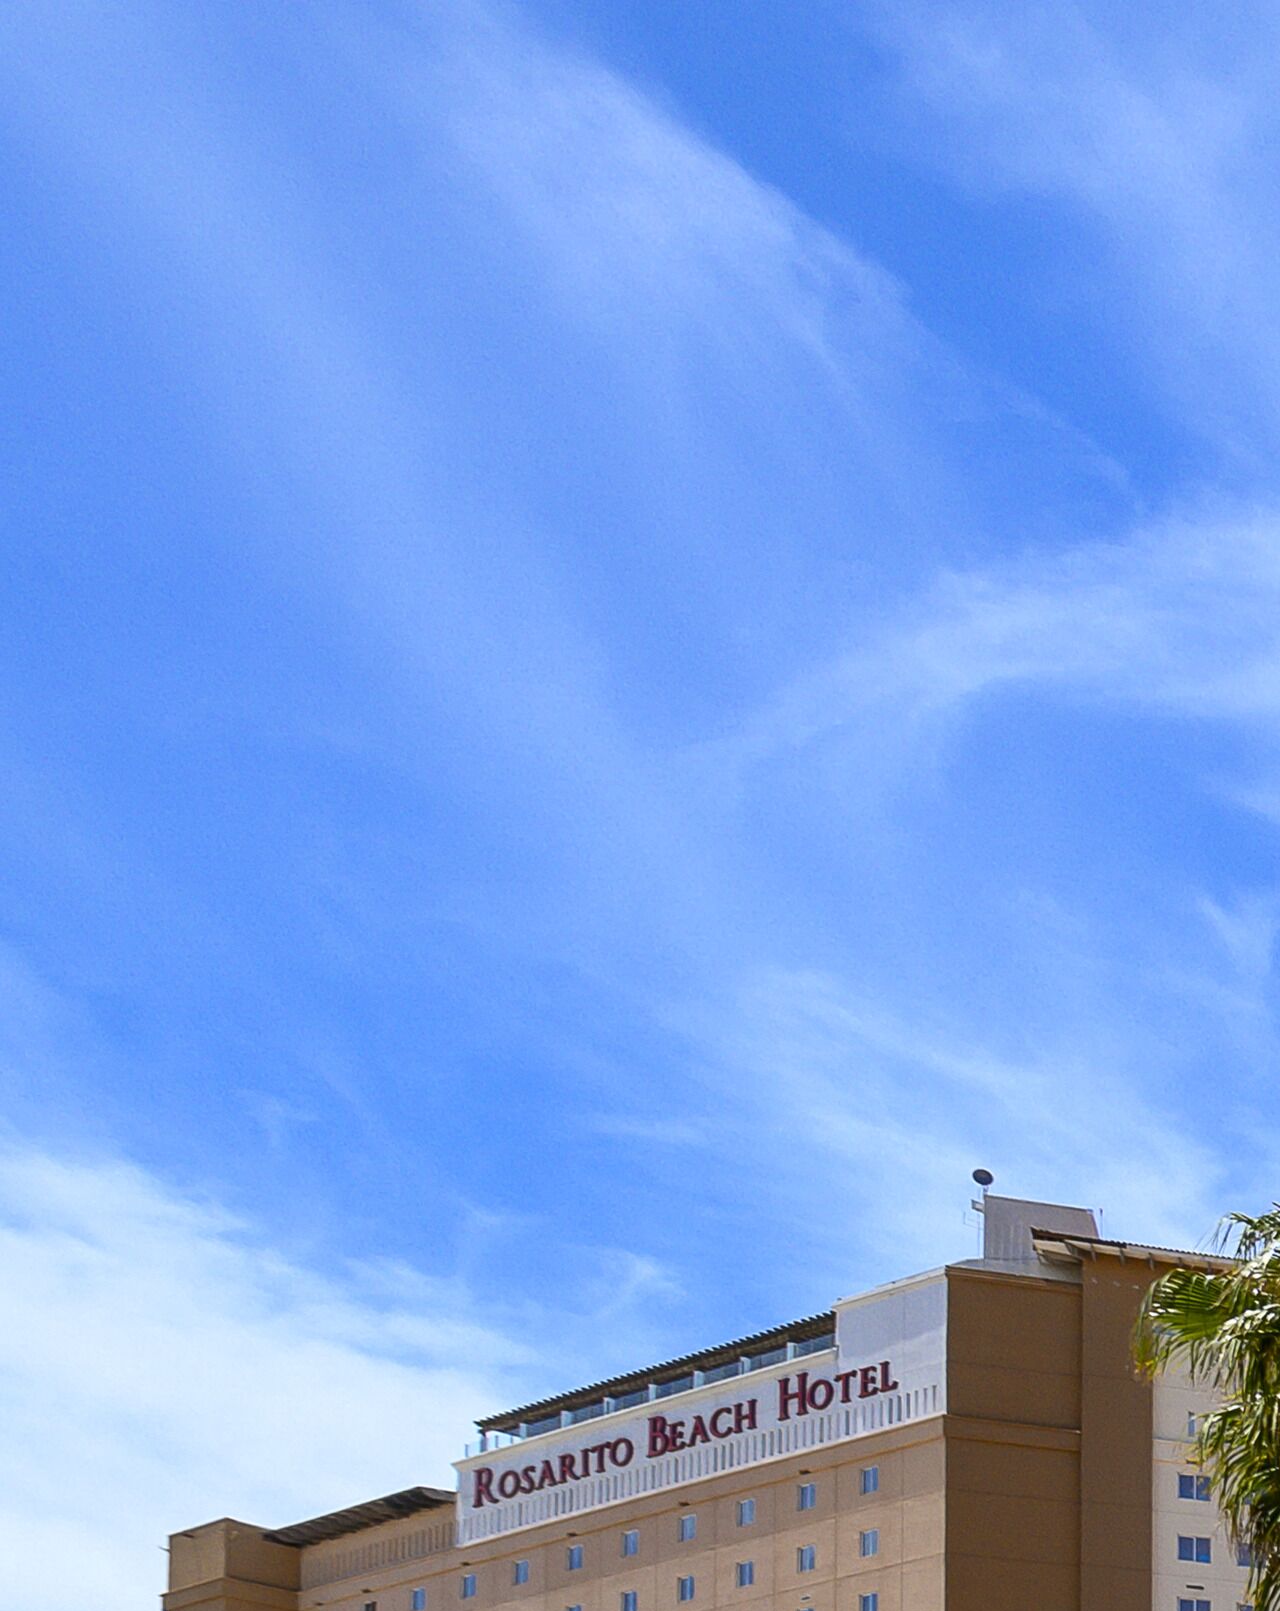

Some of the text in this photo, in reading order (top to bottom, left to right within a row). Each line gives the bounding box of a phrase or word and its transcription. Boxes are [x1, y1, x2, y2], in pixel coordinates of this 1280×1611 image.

[472, 1360, 899, 1508] ROSARITO BEACH HOTEL
